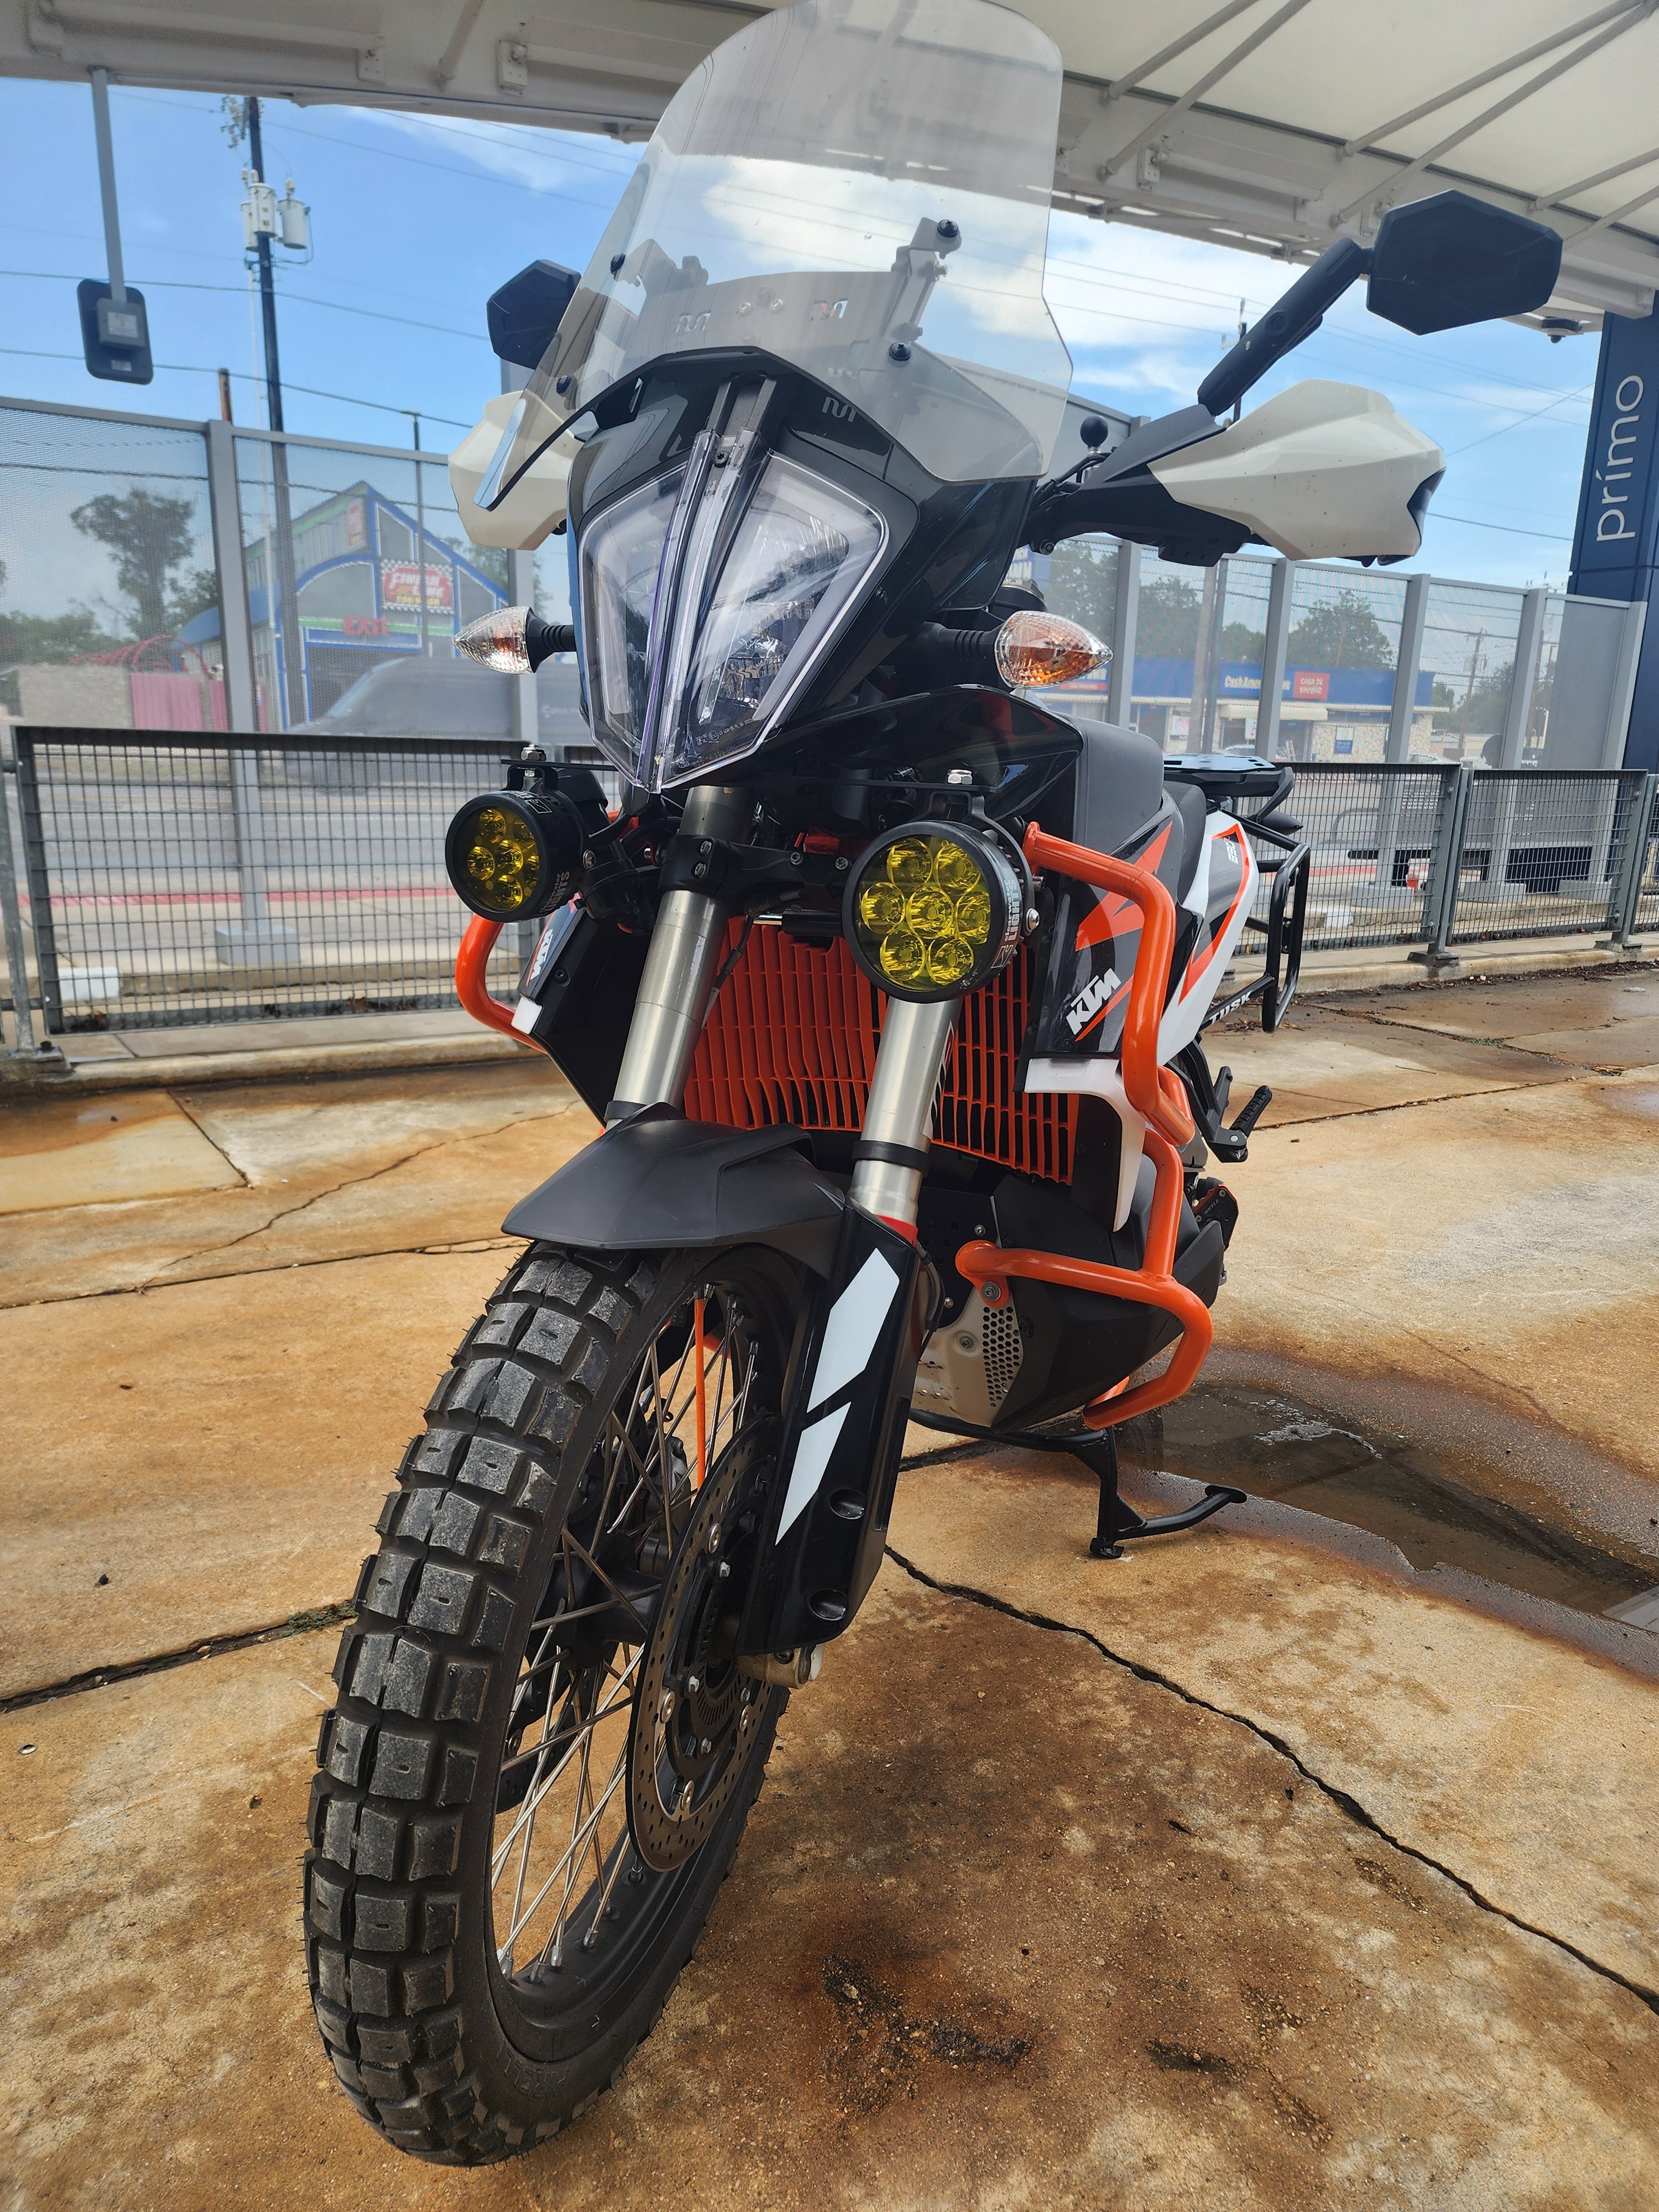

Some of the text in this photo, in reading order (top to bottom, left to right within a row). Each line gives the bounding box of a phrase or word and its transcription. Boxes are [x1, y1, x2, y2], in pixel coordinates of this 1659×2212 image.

[1595, 374, 1644, 542] prímo
[411, 585, 446, 597] LNE
[415, 596, 440, 606] WSH
[343, 615, 389, 636] EXIT
[1008, 879, 1020, 941] LIGHTS
[530, 929, 554, 980] KTM
[1065, 968, 1121, 1035] KTM
[1209, 990, 1253, 1026] TUSK
